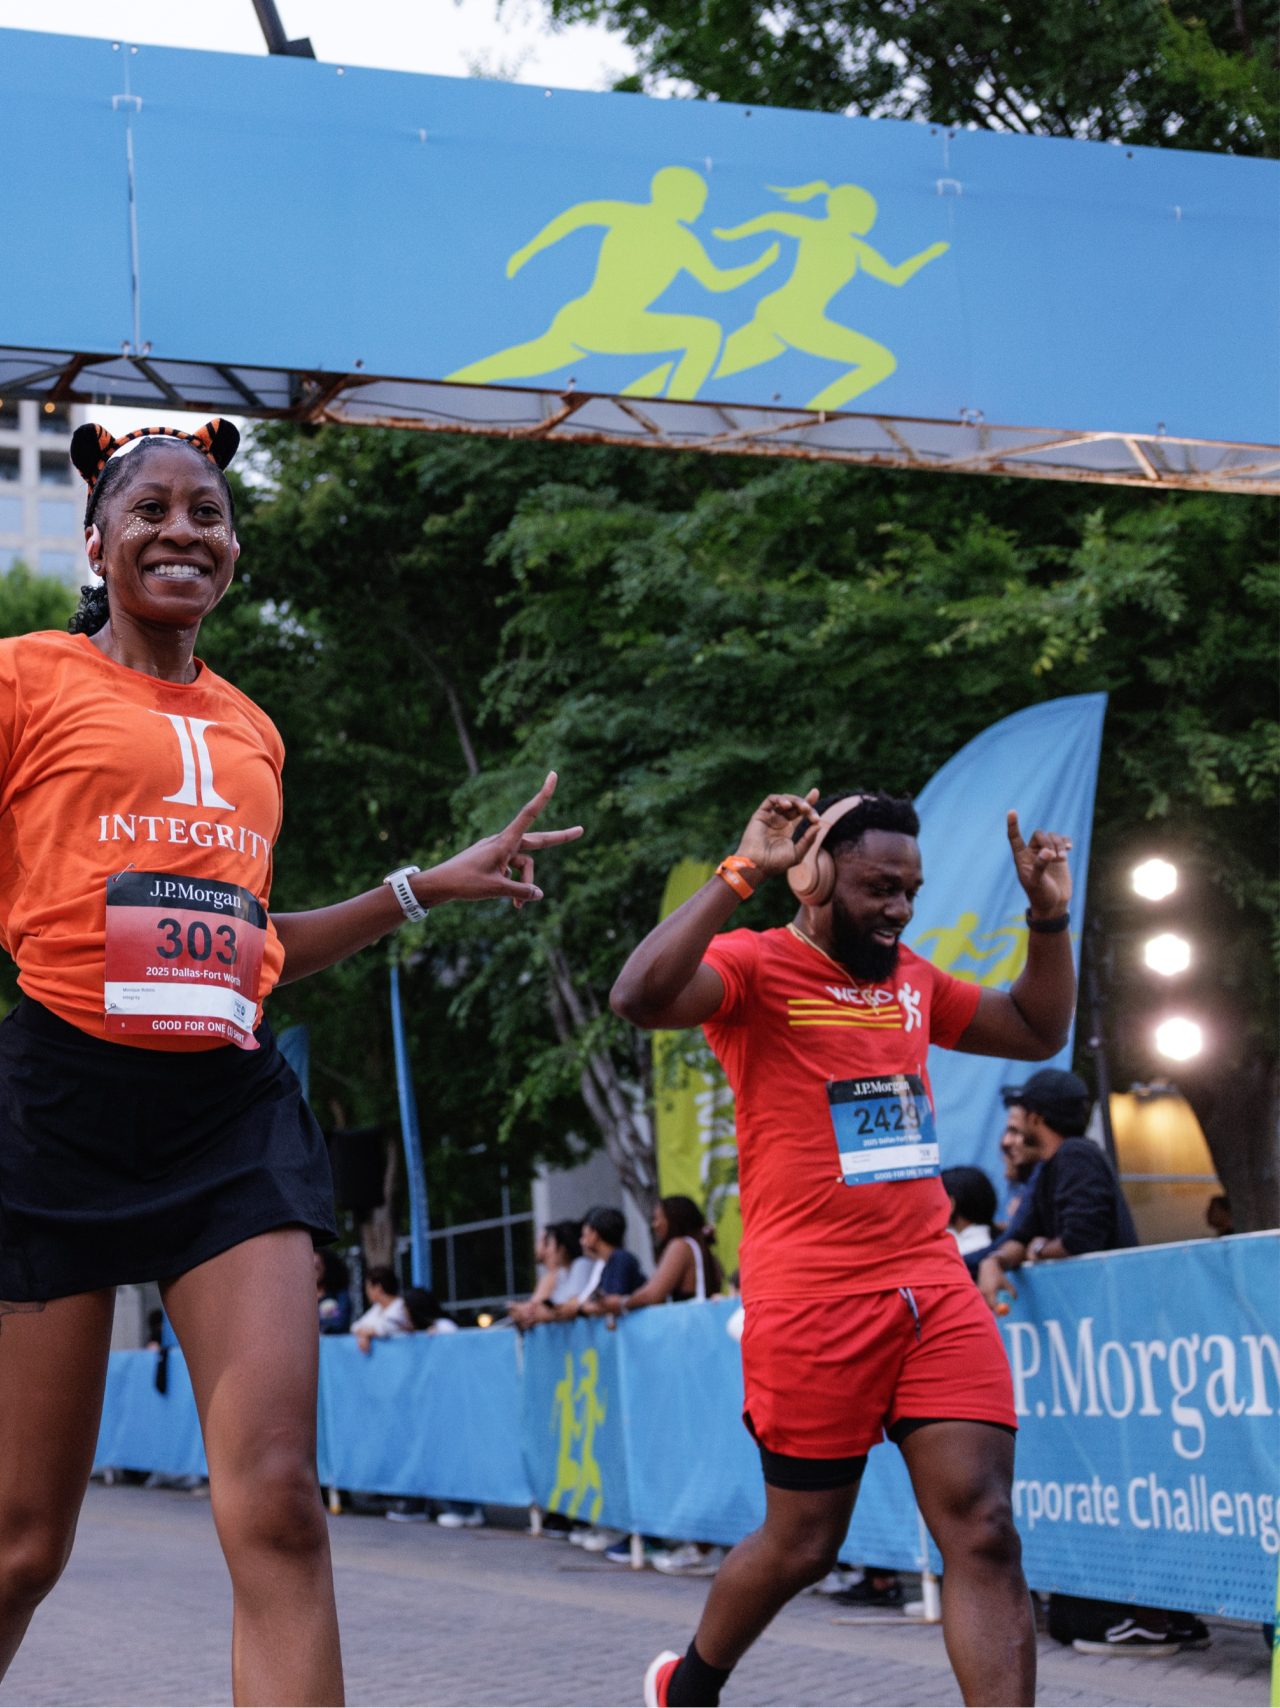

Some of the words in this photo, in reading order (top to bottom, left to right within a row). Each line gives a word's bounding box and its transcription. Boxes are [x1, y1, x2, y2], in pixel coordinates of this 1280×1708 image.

[150, 880, 242, 909] J.P.Morgan
[156, 918, 238, 965] 303
[146, 967, 169, 976] 2025
[171, 967, 222, 981] Dallas-Fort
[152, 1020, 182, 1030] GOOD
[184, 1021, 205, 1031] FOR
[207, 1022, 226, 1033] ONE
[853, 1081, 911, 1096] J.P.Morgan
[1012, 1475, 1121, 1531] rporate
[1127, 1472, 1280, 1554] Challeng
